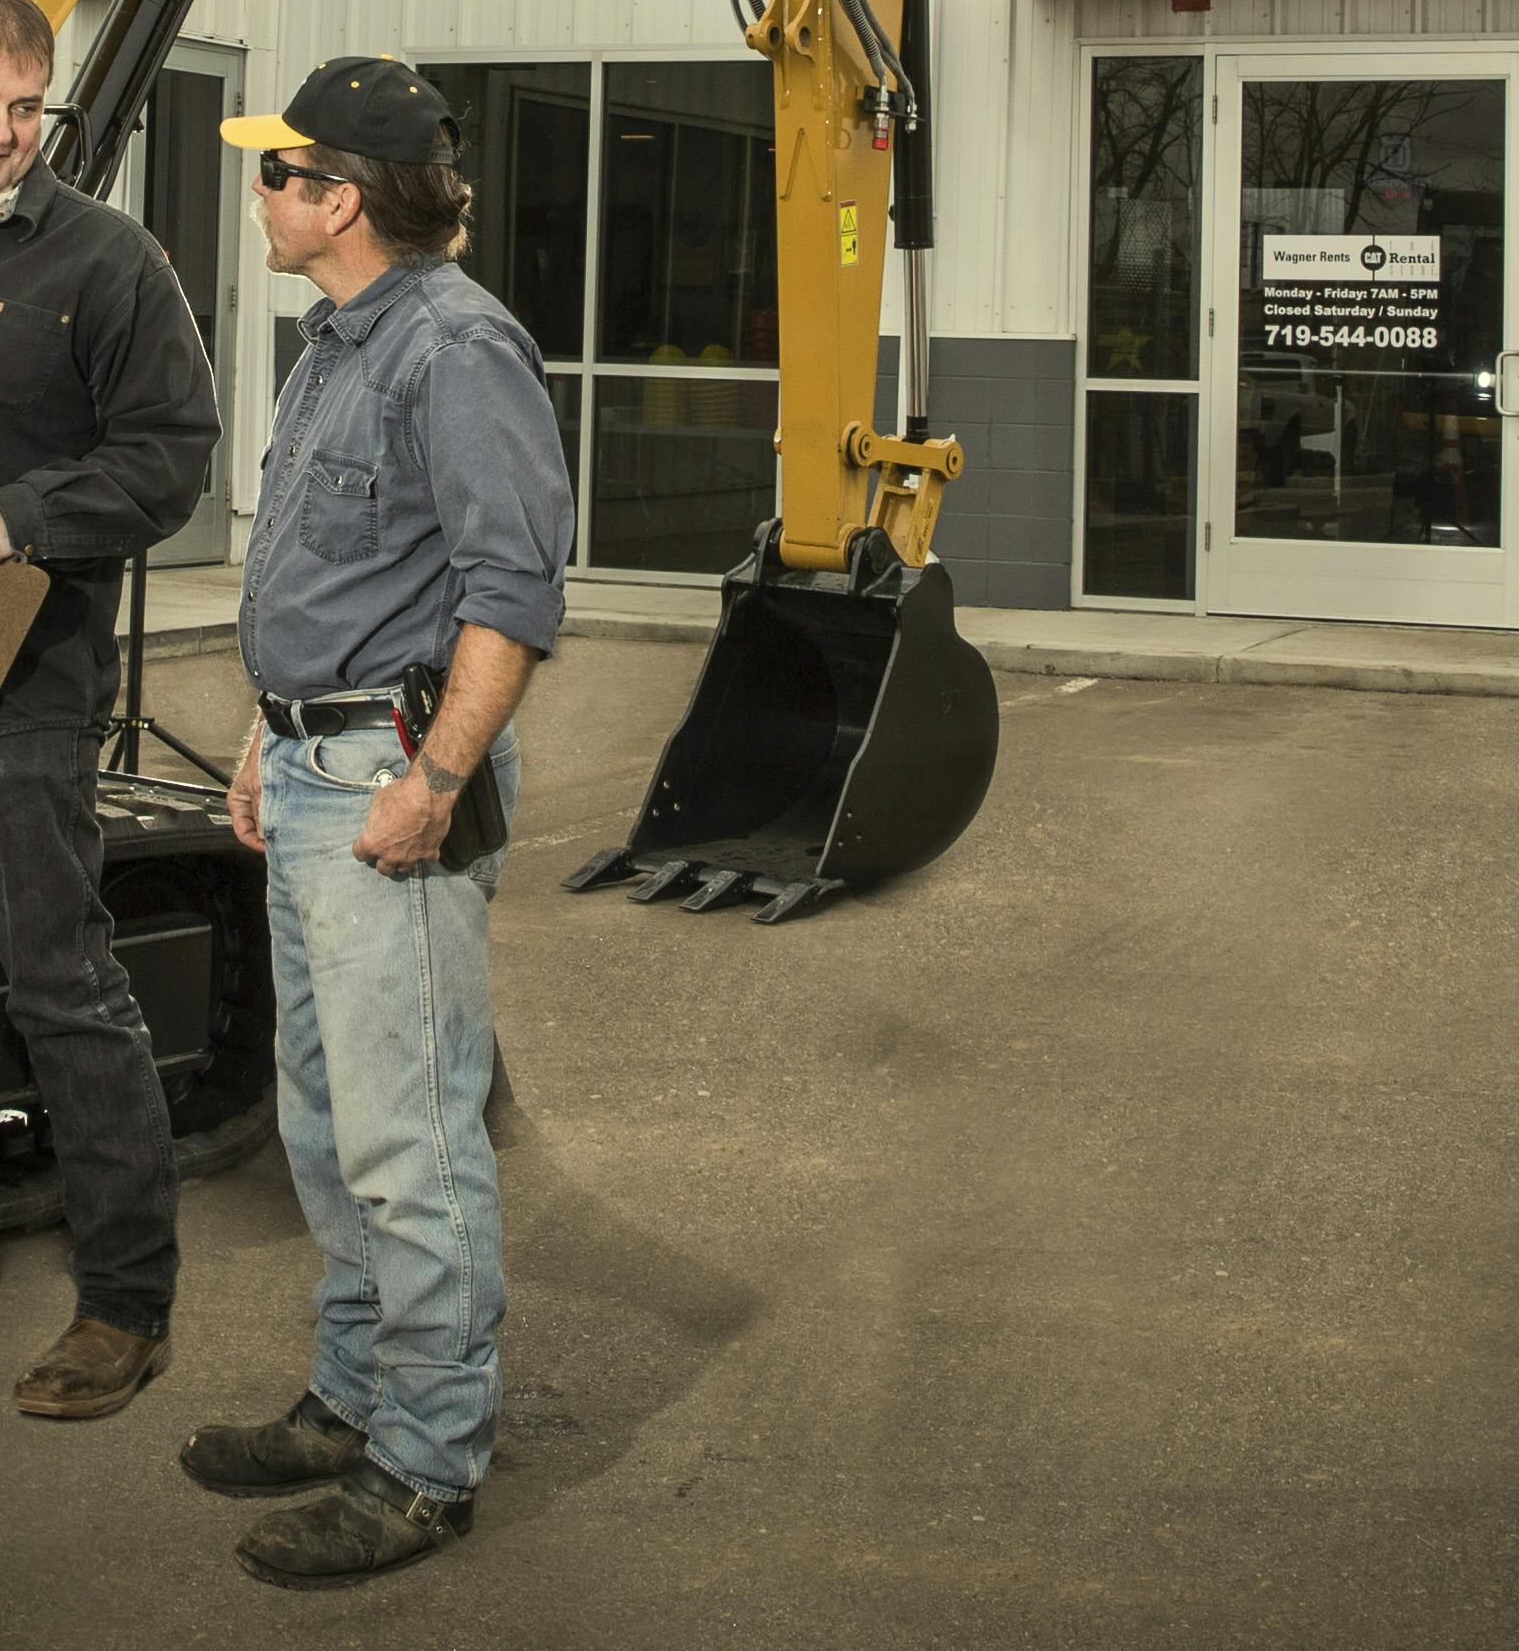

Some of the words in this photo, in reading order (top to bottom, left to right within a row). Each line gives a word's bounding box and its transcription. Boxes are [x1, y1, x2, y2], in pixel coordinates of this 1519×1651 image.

[1273, 251, 1317, 264] Wagner
[1320, 251, 1351, 262] Rents
[1364, 252, 1382, 264] CAT
[1389, 253, 1435, 264] Rental
[1264, 287, 1313, 299] Monday
[1324, 288, 1367, 300] Friday:
[1371, 289, 1399, 299] 7AM
[1410, 289, 1438, 299] 5PM
[1264, 304, 1310, 315] Closed
[1314, 305, 1376, 319] Saturday
[1387, 306, 1438, 319] Sunday
[1264, 325, 1438, 348] 719-544-0088
